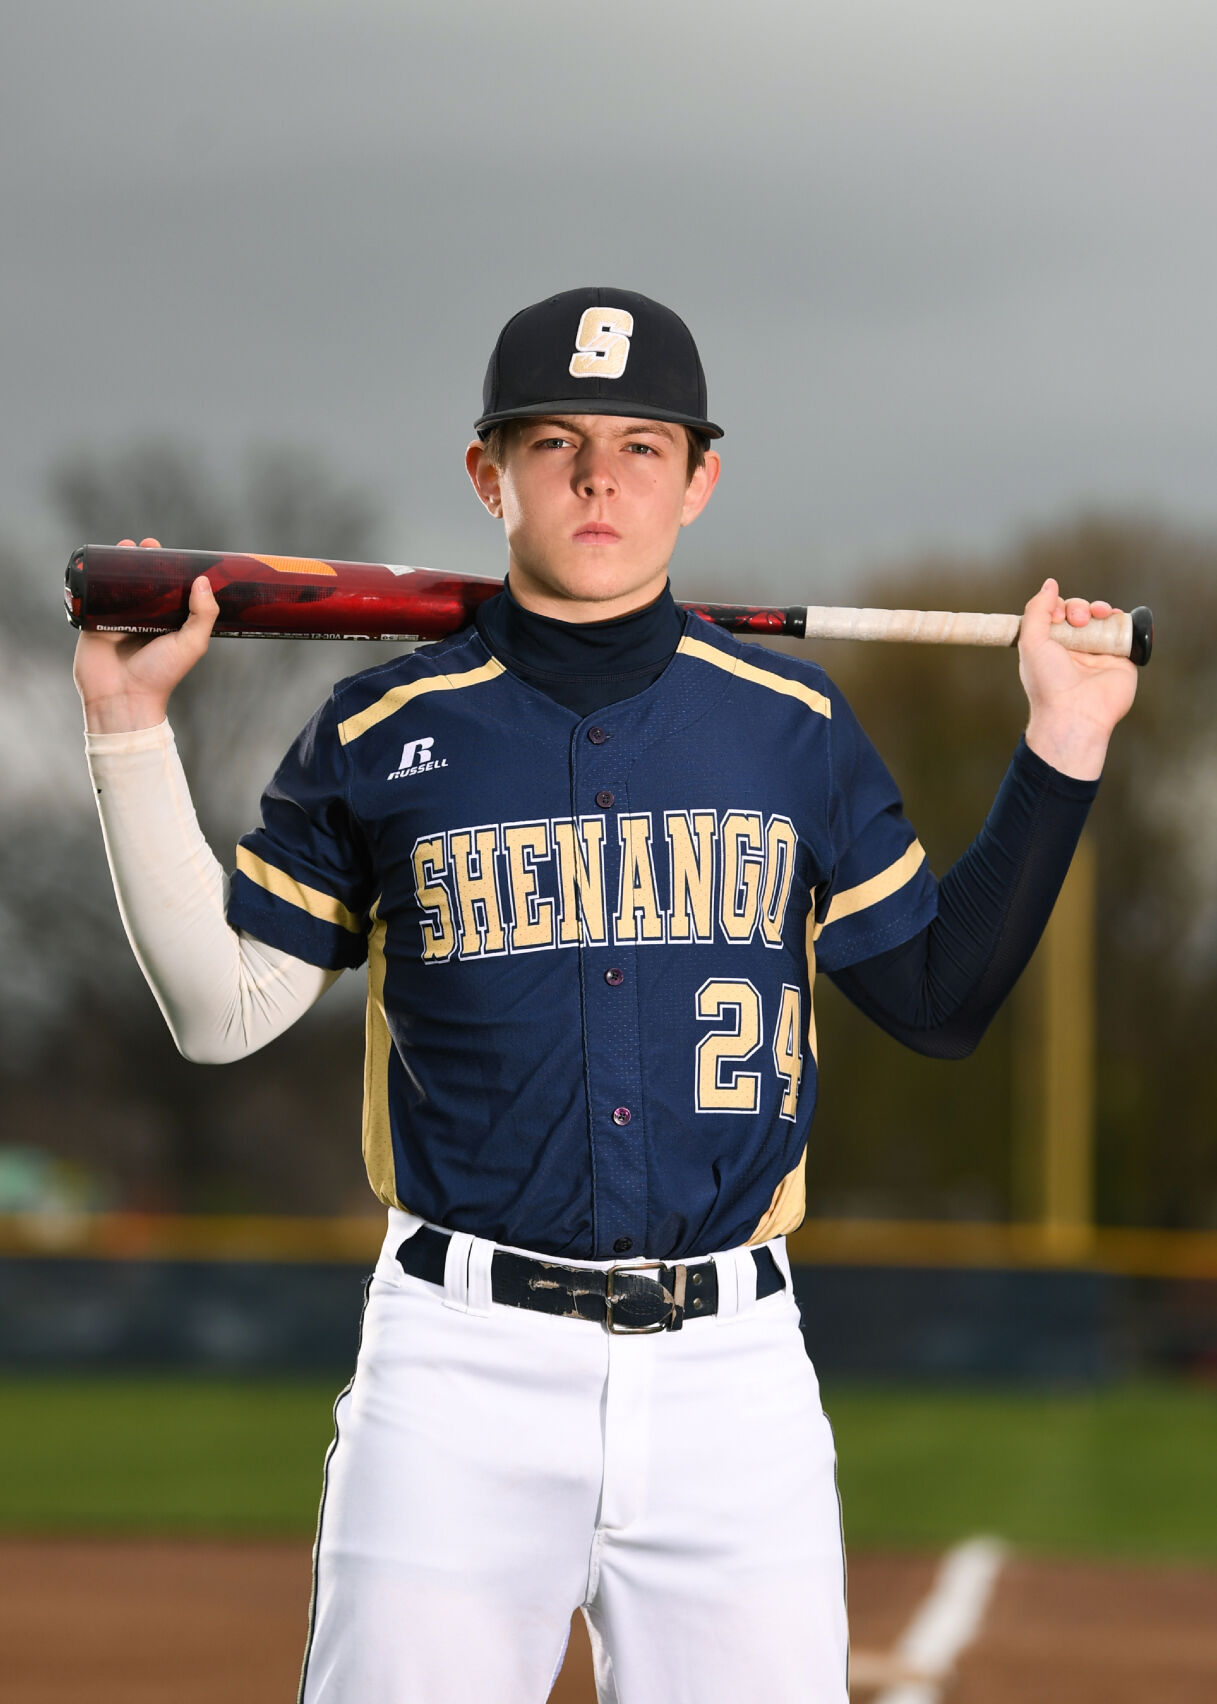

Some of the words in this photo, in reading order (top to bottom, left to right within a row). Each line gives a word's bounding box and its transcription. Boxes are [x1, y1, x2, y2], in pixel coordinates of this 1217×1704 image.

[568, 306, 634, 379] S
[386, 758, 449, 781] RUSSELL
[410, 808, 799, 965] SHENANGO
[694, 977, 802, 1123] 24
